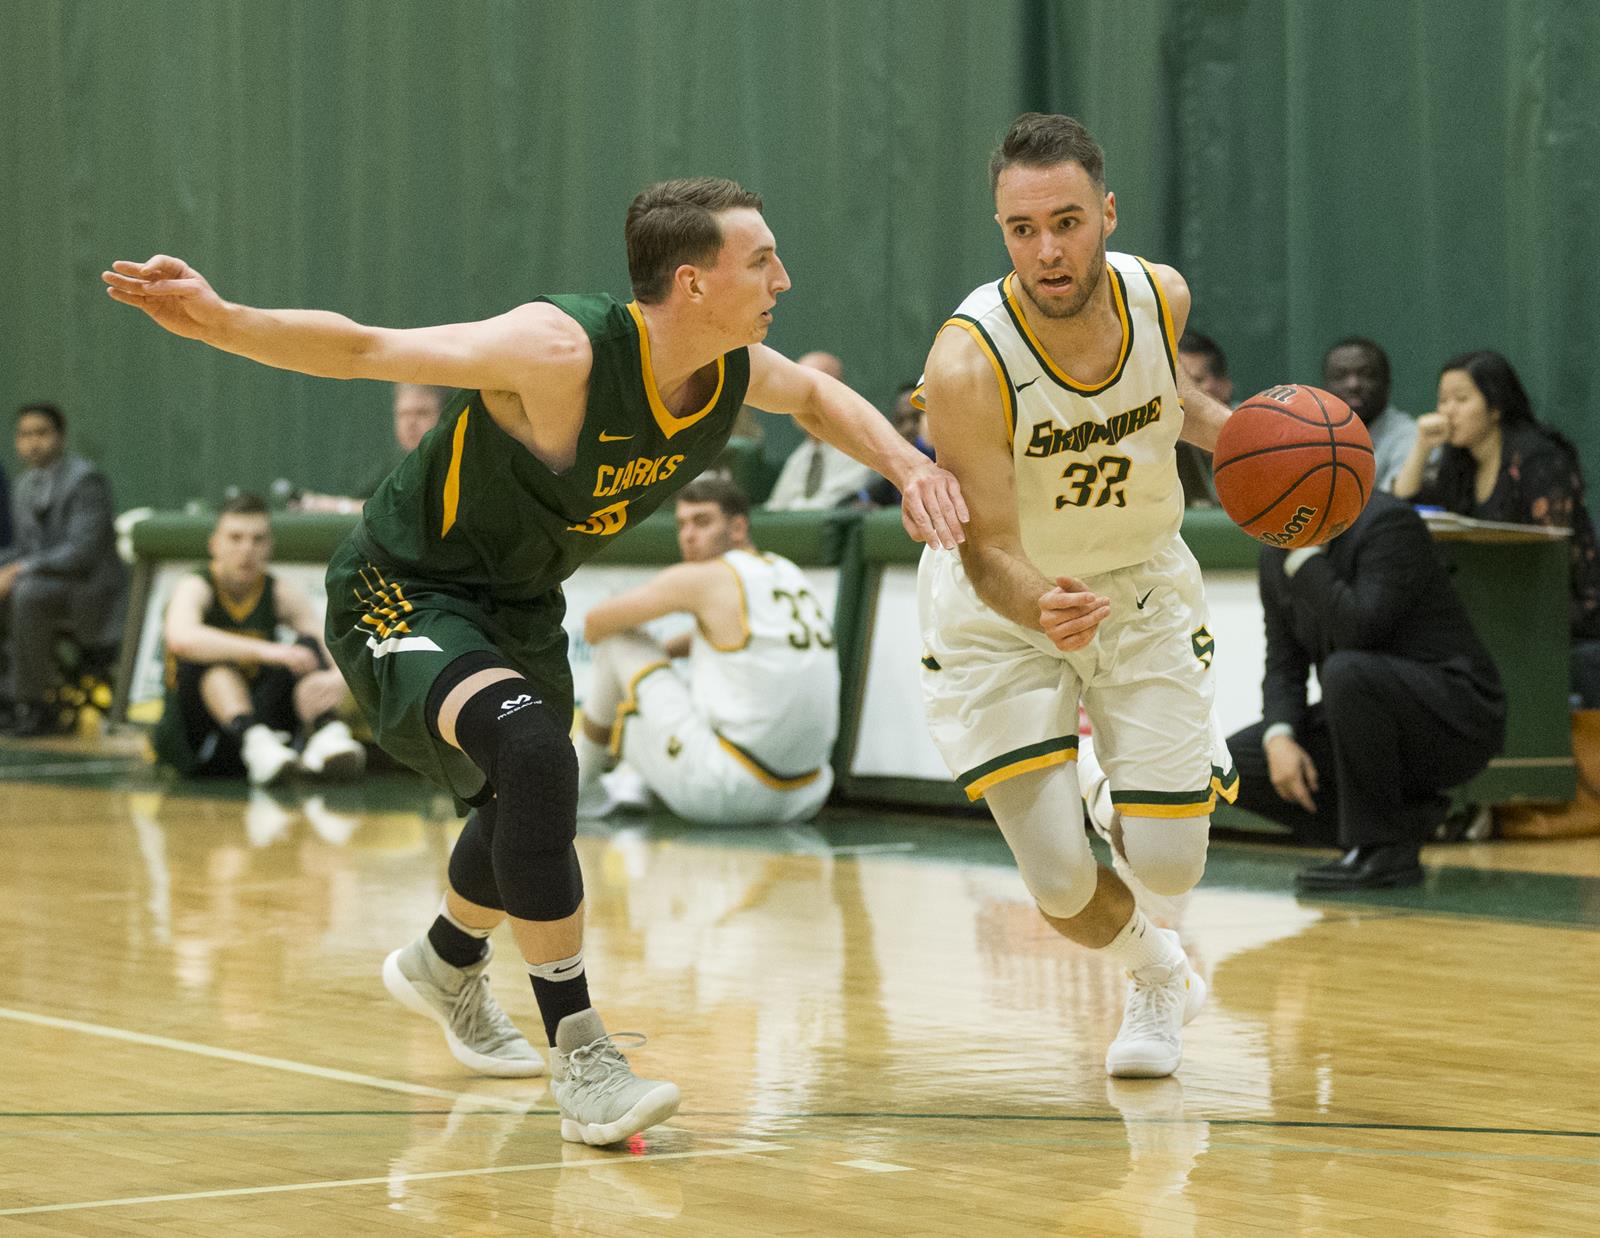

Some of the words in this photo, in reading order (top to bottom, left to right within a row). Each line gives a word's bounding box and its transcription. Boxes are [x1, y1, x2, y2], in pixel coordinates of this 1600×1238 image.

[1025, 396, 1161, 457] SKIDMORE
[1055, 456, 1132, 511] 32
[773, 589, 834, 651] 33
